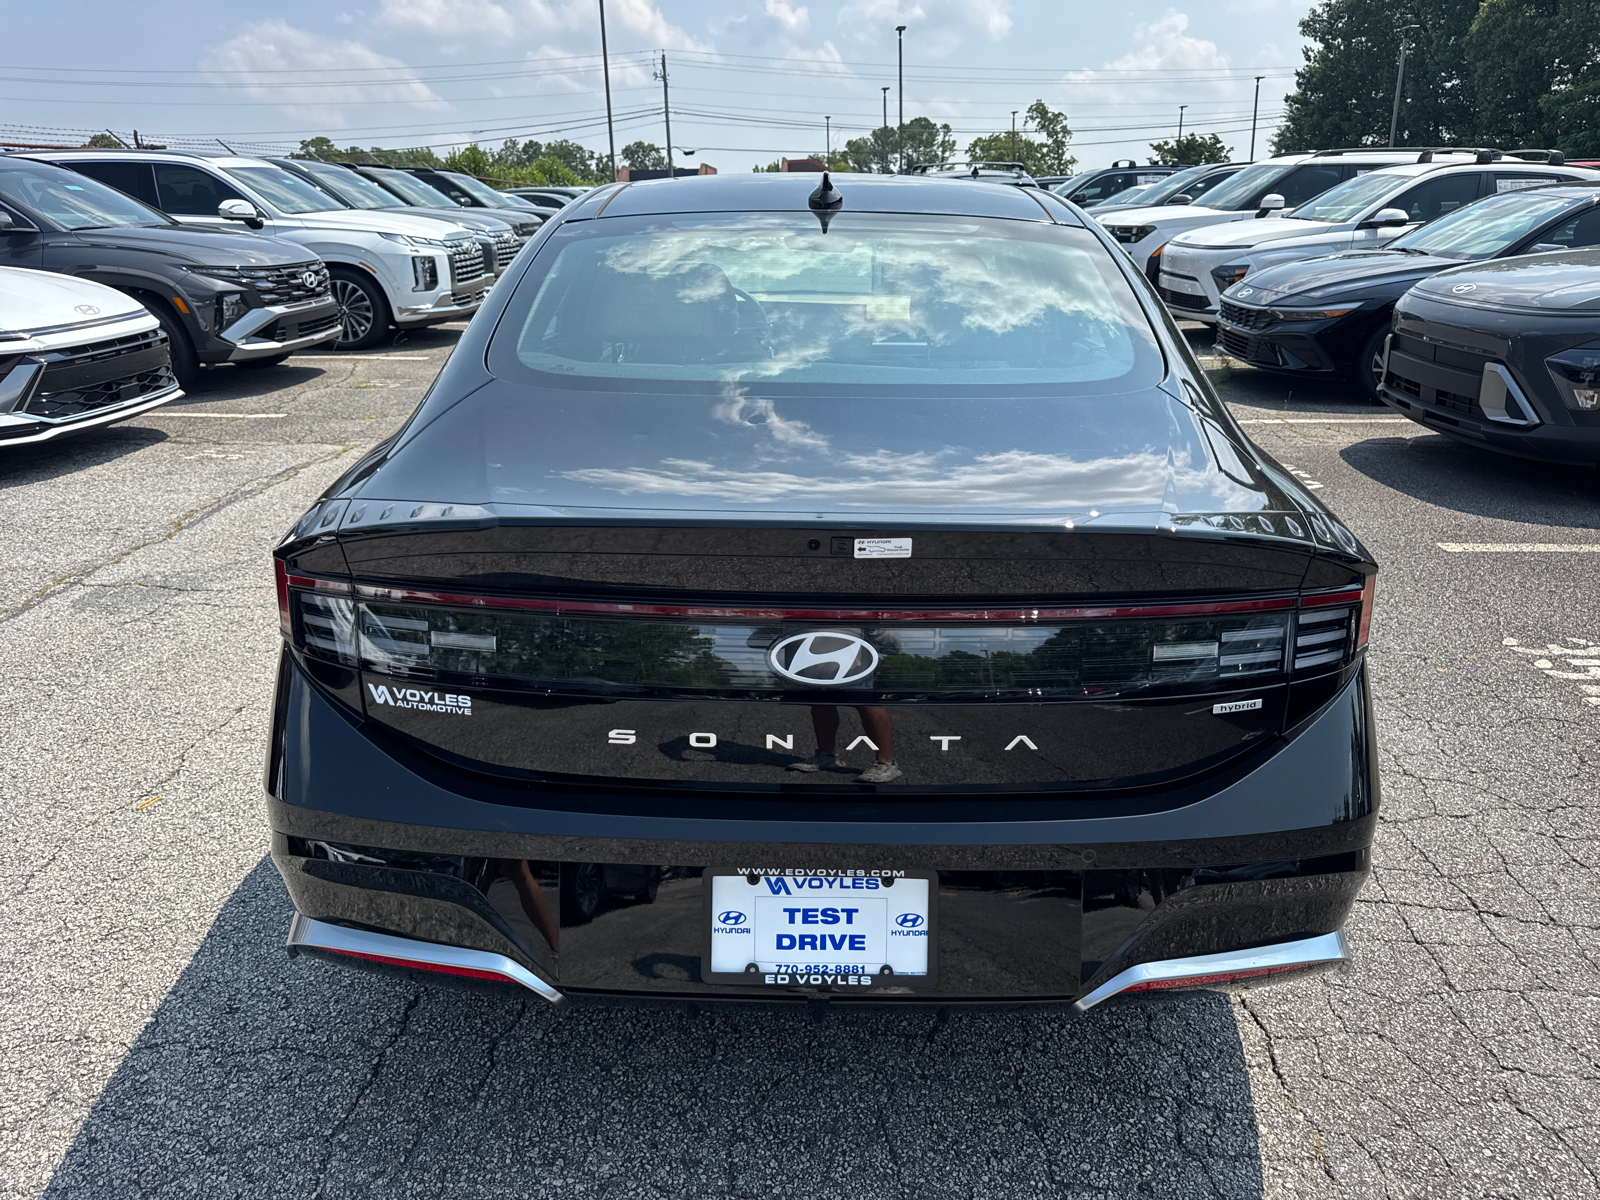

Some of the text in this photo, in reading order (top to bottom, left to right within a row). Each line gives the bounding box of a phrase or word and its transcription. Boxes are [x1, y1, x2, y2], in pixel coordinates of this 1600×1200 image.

[392, 687, 472, 707] VOYLES
[395, 700, 472, 716] AUTOMOTIVE
[1220, 701, 1257, 713] hybrid
[607, 728, 1039, 751] SONATA
[737, 867, 905, 878] WWW.EDVOYLES.COM
[792, 877, 880, 890] VOYLES
[782, 907, 859, 925] TEST
[713, 926, 751, 935] HYUNDAI
[890, 929, 929, 937] HYUNDAI
[775, 933, 866, 951] DRIVE
[775, 963, 866, 974] 770-952-8881
[764, 974, 872, 986] ED VOYLES
